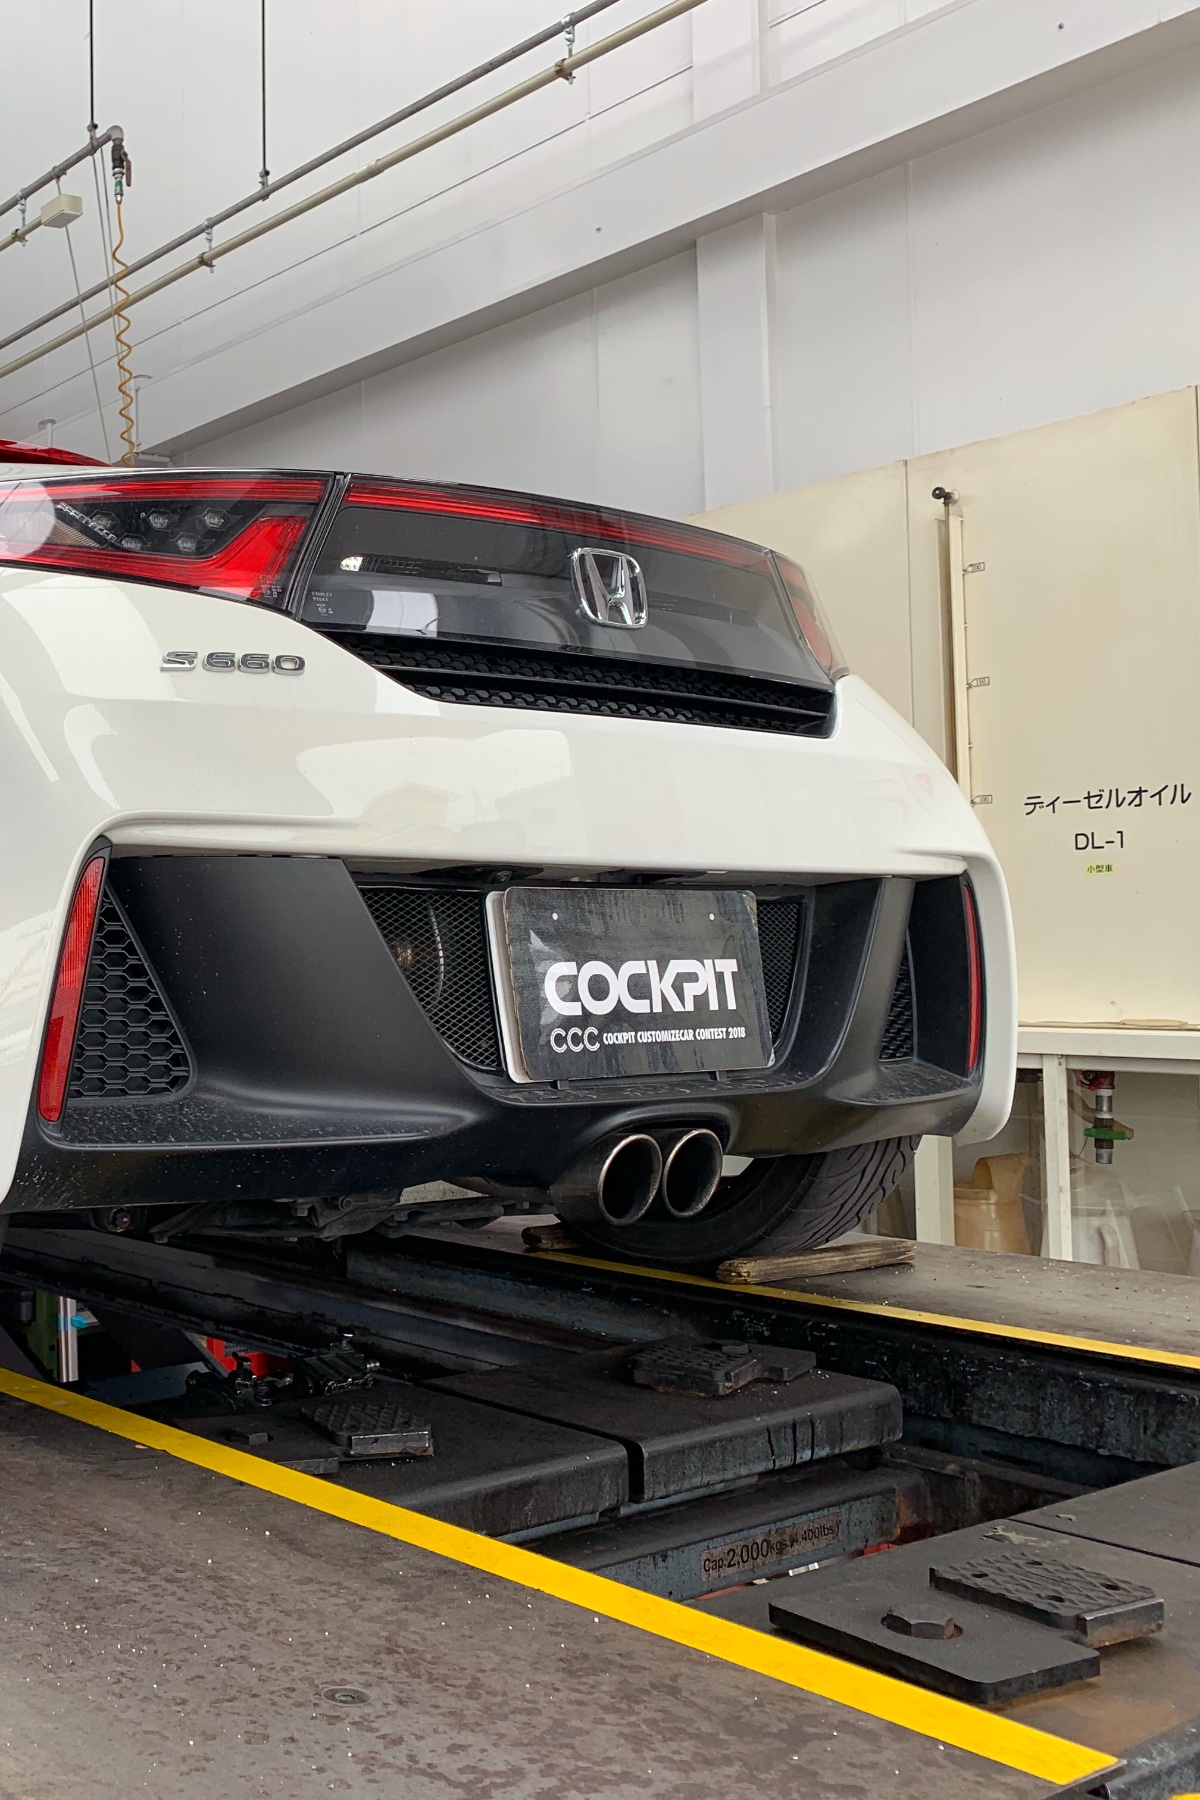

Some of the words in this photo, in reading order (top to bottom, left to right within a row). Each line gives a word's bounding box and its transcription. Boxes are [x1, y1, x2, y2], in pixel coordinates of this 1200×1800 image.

[160, 651, 306, 676] S660
[1024, 783, 1192, 815] ディーゼルオイル
[1074, 830, 1124, 851] DL-1
[1087, 864, 1113, 874] 小型車
[544, 959, 738, 1016] COCKPIT
[550, 1026, 601, 1054] CCC
[603, 1031, 636, 1045] COCKPIT
[637, 1028, 695, 1043] CUSTOMIZECAR
[695, 1027, 727, 1041] CONTEST
[728, 1026, 746, 1039] 2018
